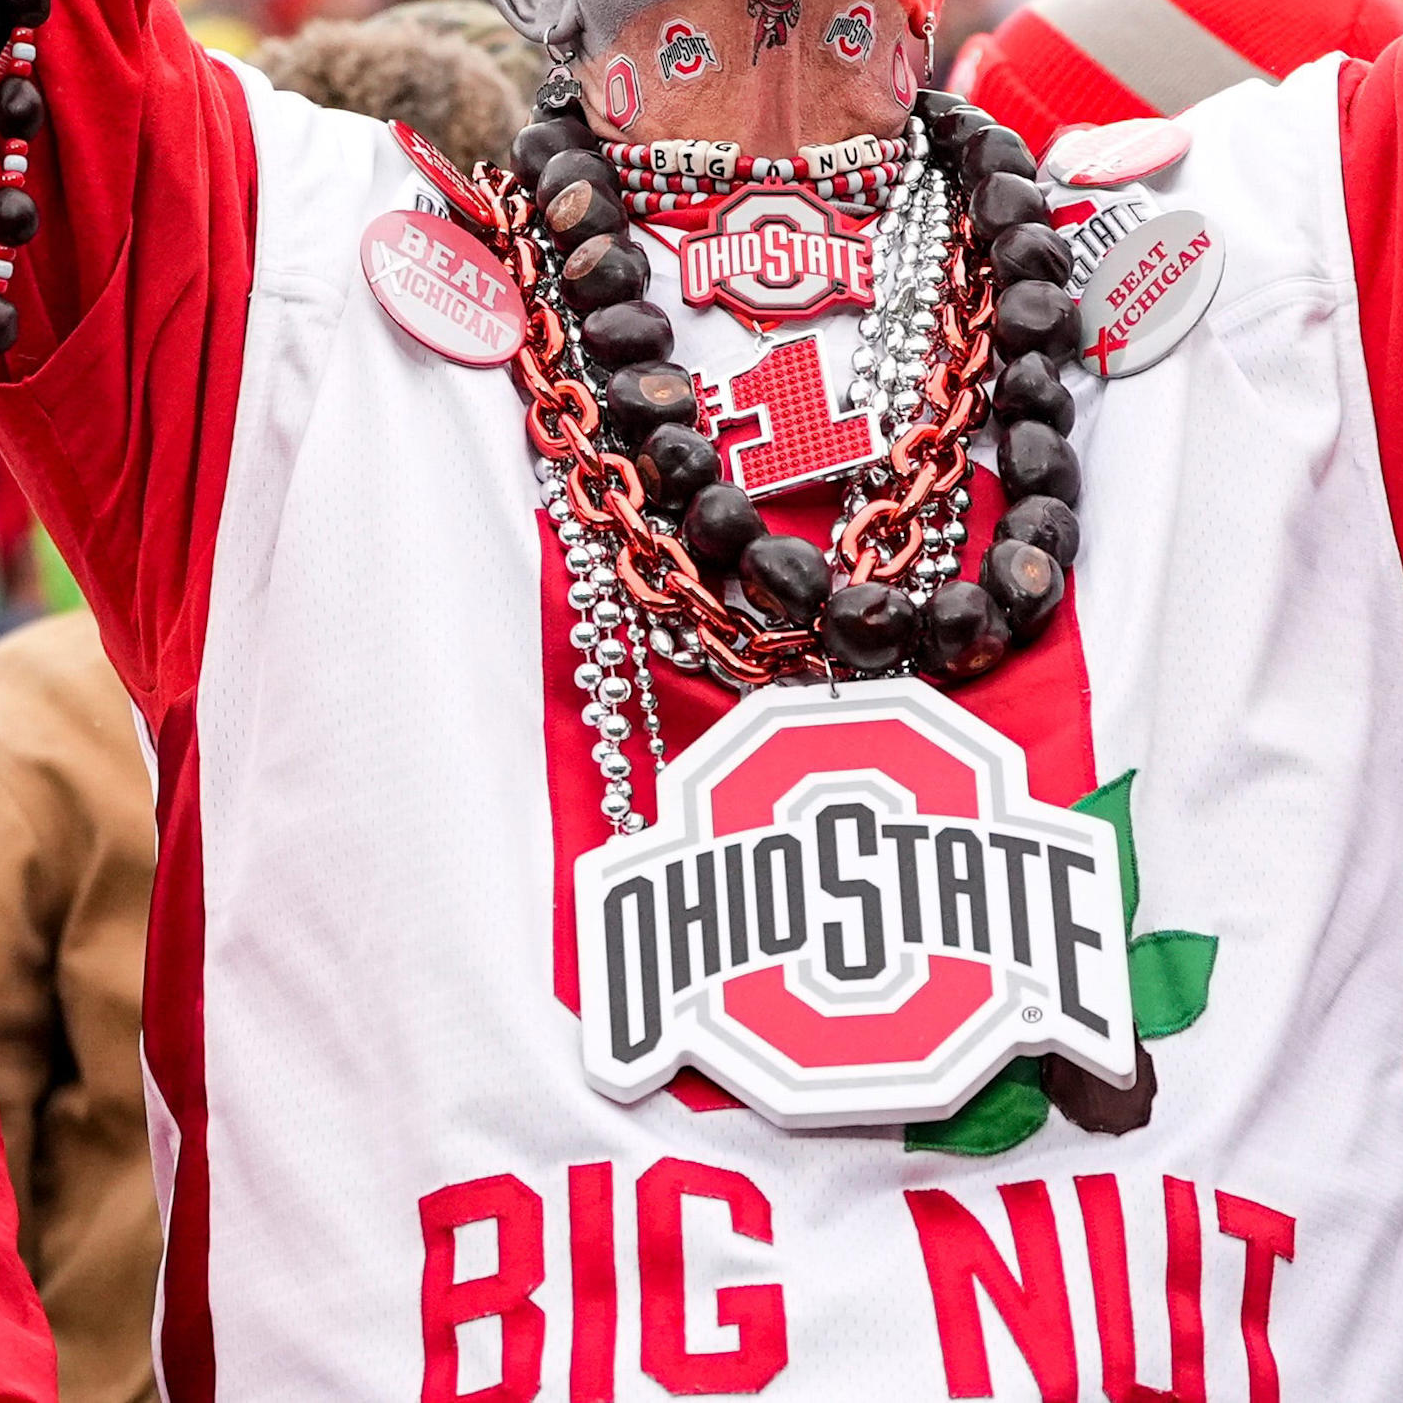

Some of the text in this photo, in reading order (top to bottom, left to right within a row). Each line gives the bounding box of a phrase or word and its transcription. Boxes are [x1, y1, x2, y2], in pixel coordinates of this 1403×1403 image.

[660, 36, 715, 80] OHIO STATE
[654, 139, 878, 176] BIG NUT
[371, 240, 503, 350] ICHIGAN
[400, 223, 507, 310] BEAT
[686, 223, 871, 298] OHIO STATE
[1105, 240, 1170, 312] BEAT
[603, 802, 1111, 1065] OHIO STATE
[419, 1156, 1296, 1403] BIG NUT
